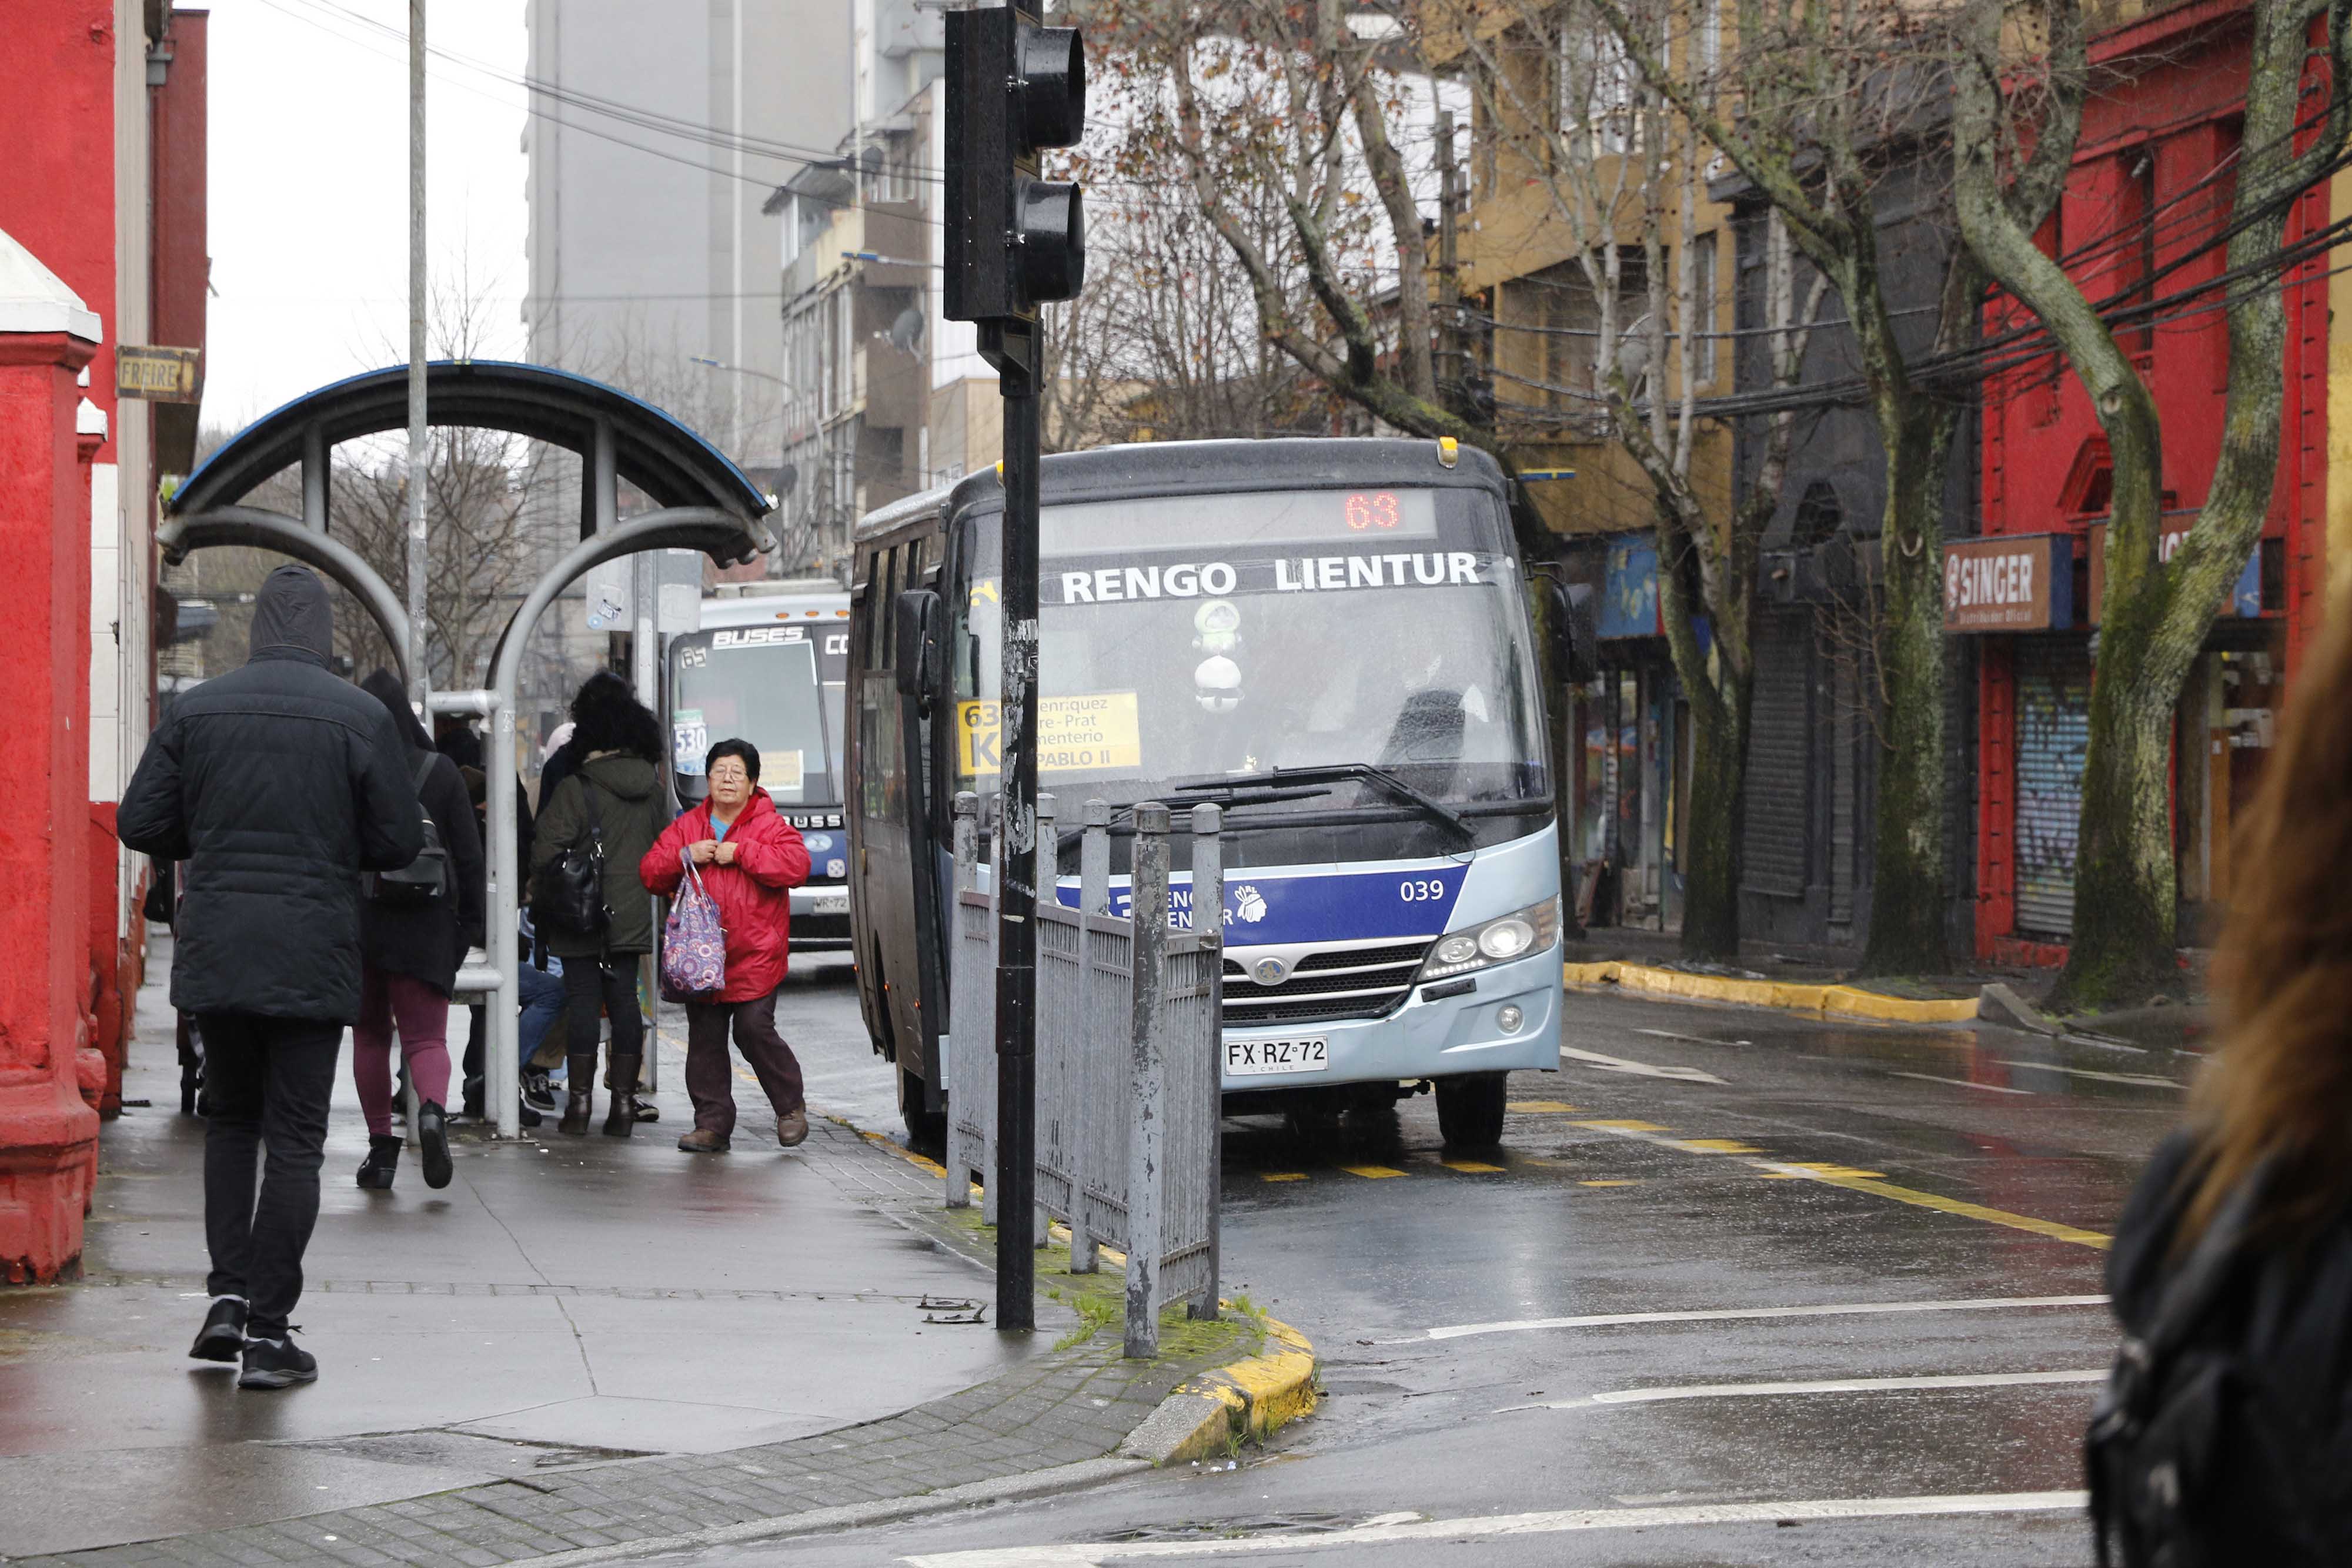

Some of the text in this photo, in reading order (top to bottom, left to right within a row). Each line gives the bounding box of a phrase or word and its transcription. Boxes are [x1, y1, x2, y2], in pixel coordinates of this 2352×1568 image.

[1345, 494, 1399, 529] 63
[1062, 552, 1480, 604] RENGO LIENTUR
[1960, 554, 2033, 605] SINGER
[711, 626, 804, 646] BUSES
[965, 704, 999, 728] 63
[1065, 714, 1096, 727] Prat
[676, 727, 707, 753] 530
[971, 733, 1000, 767] K
[1400, 880, 1444, 902] 039
